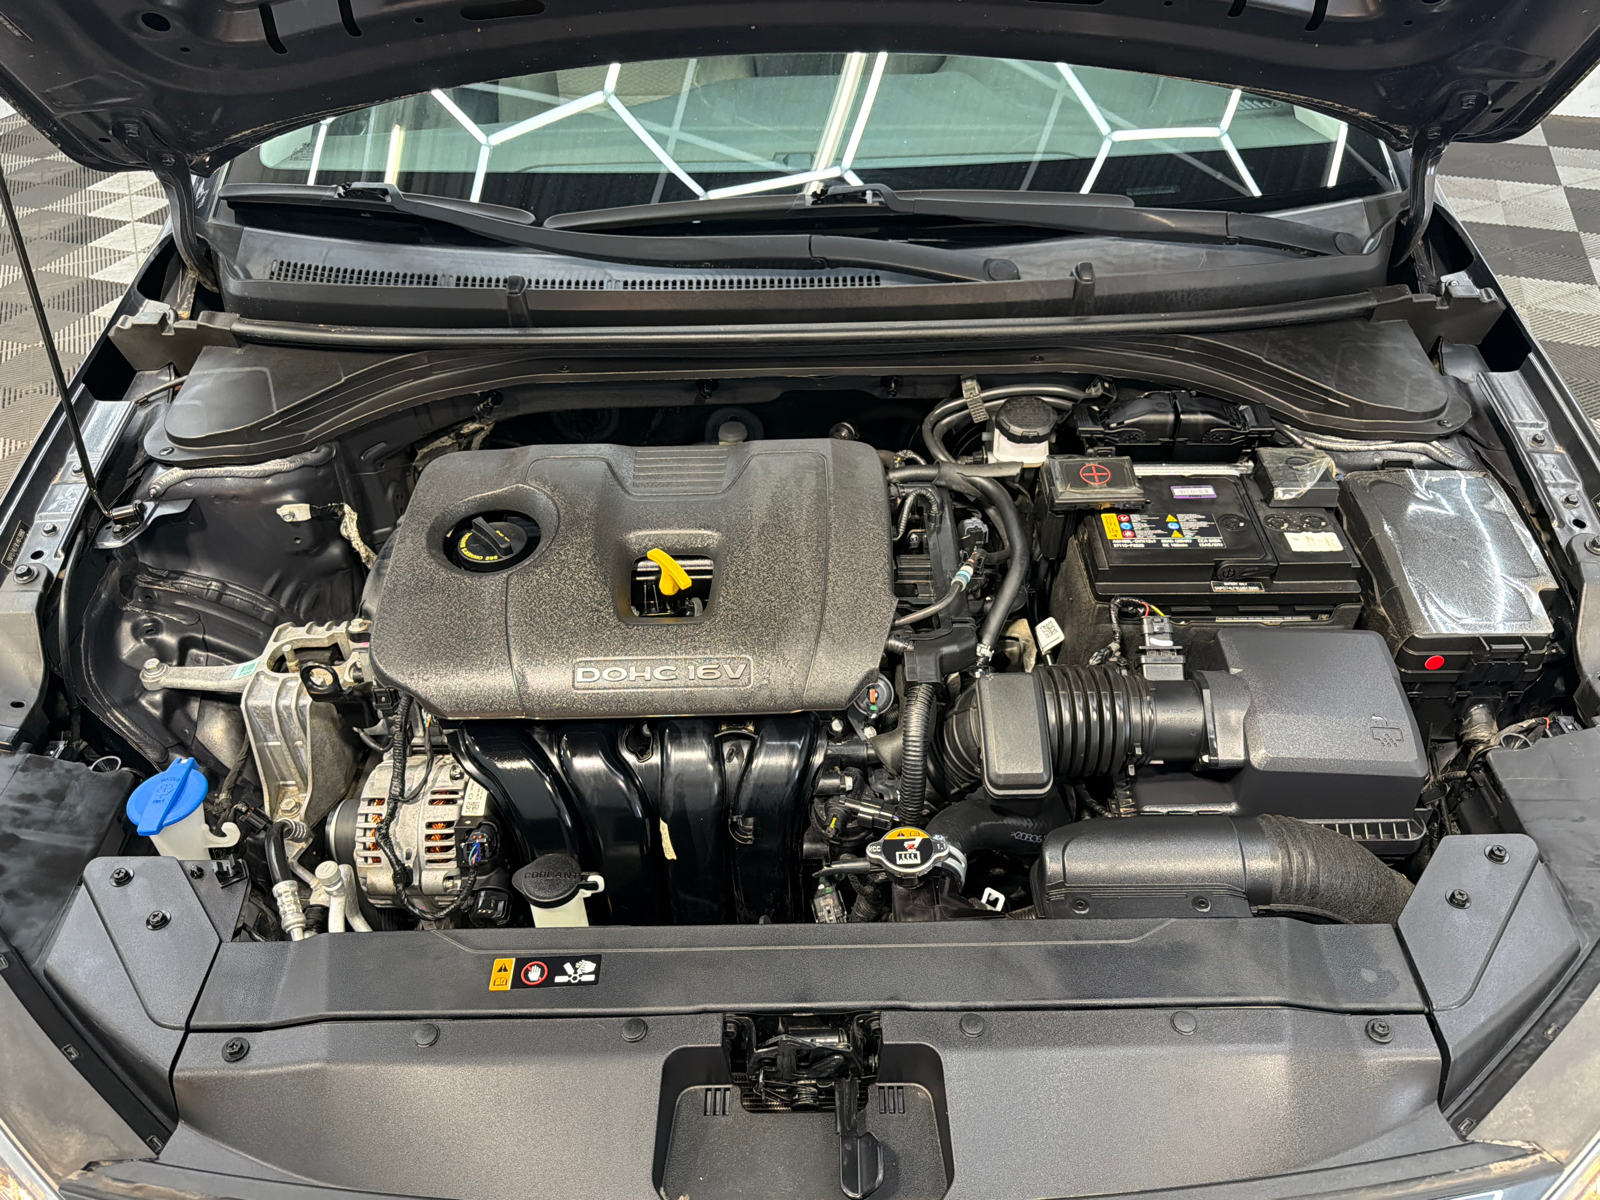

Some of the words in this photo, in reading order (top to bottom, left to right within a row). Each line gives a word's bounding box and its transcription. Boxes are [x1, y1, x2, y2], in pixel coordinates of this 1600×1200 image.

[576, 665, 677, 683] DOHC
[687, 663, 748, 680] 16V
[524, 871, 579, 880] COOLANT
